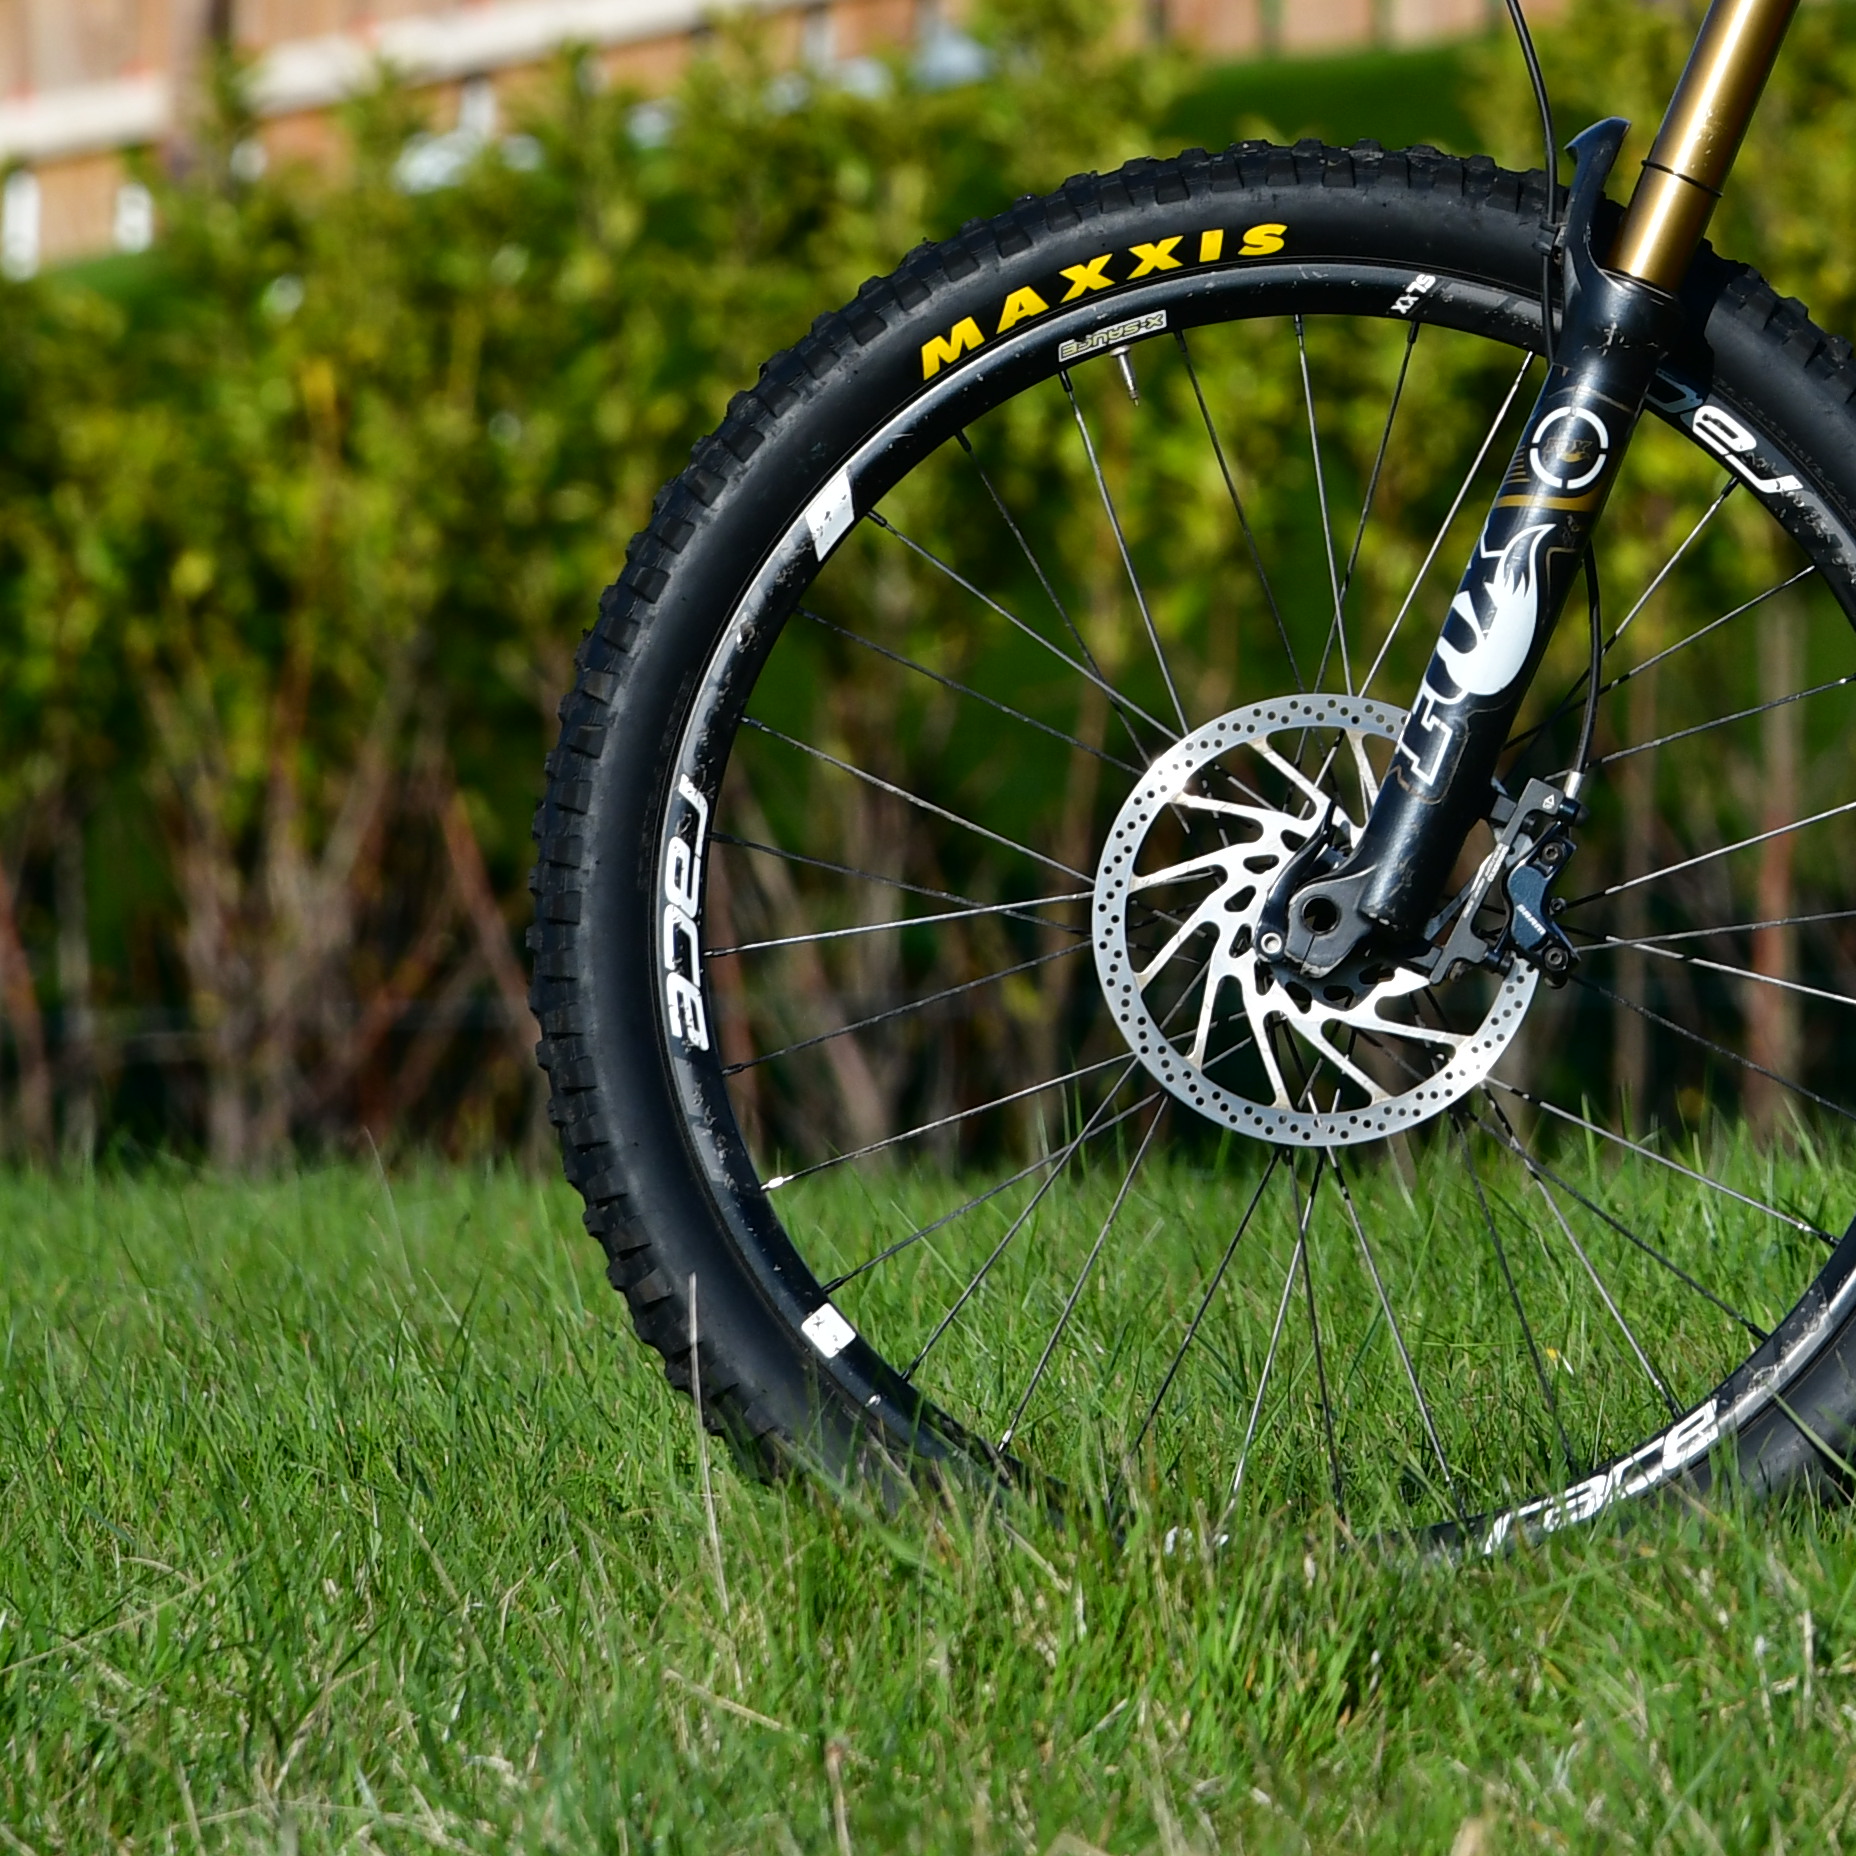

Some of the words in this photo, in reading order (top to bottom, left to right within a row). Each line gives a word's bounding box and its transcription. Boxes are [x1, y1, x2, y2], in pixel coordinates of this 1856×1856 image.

[921, 223, 1288, 381] MAXXIS
[1061, 312, 1164, 359] X-SAUCE
[664, 773, 709, 1052] race
